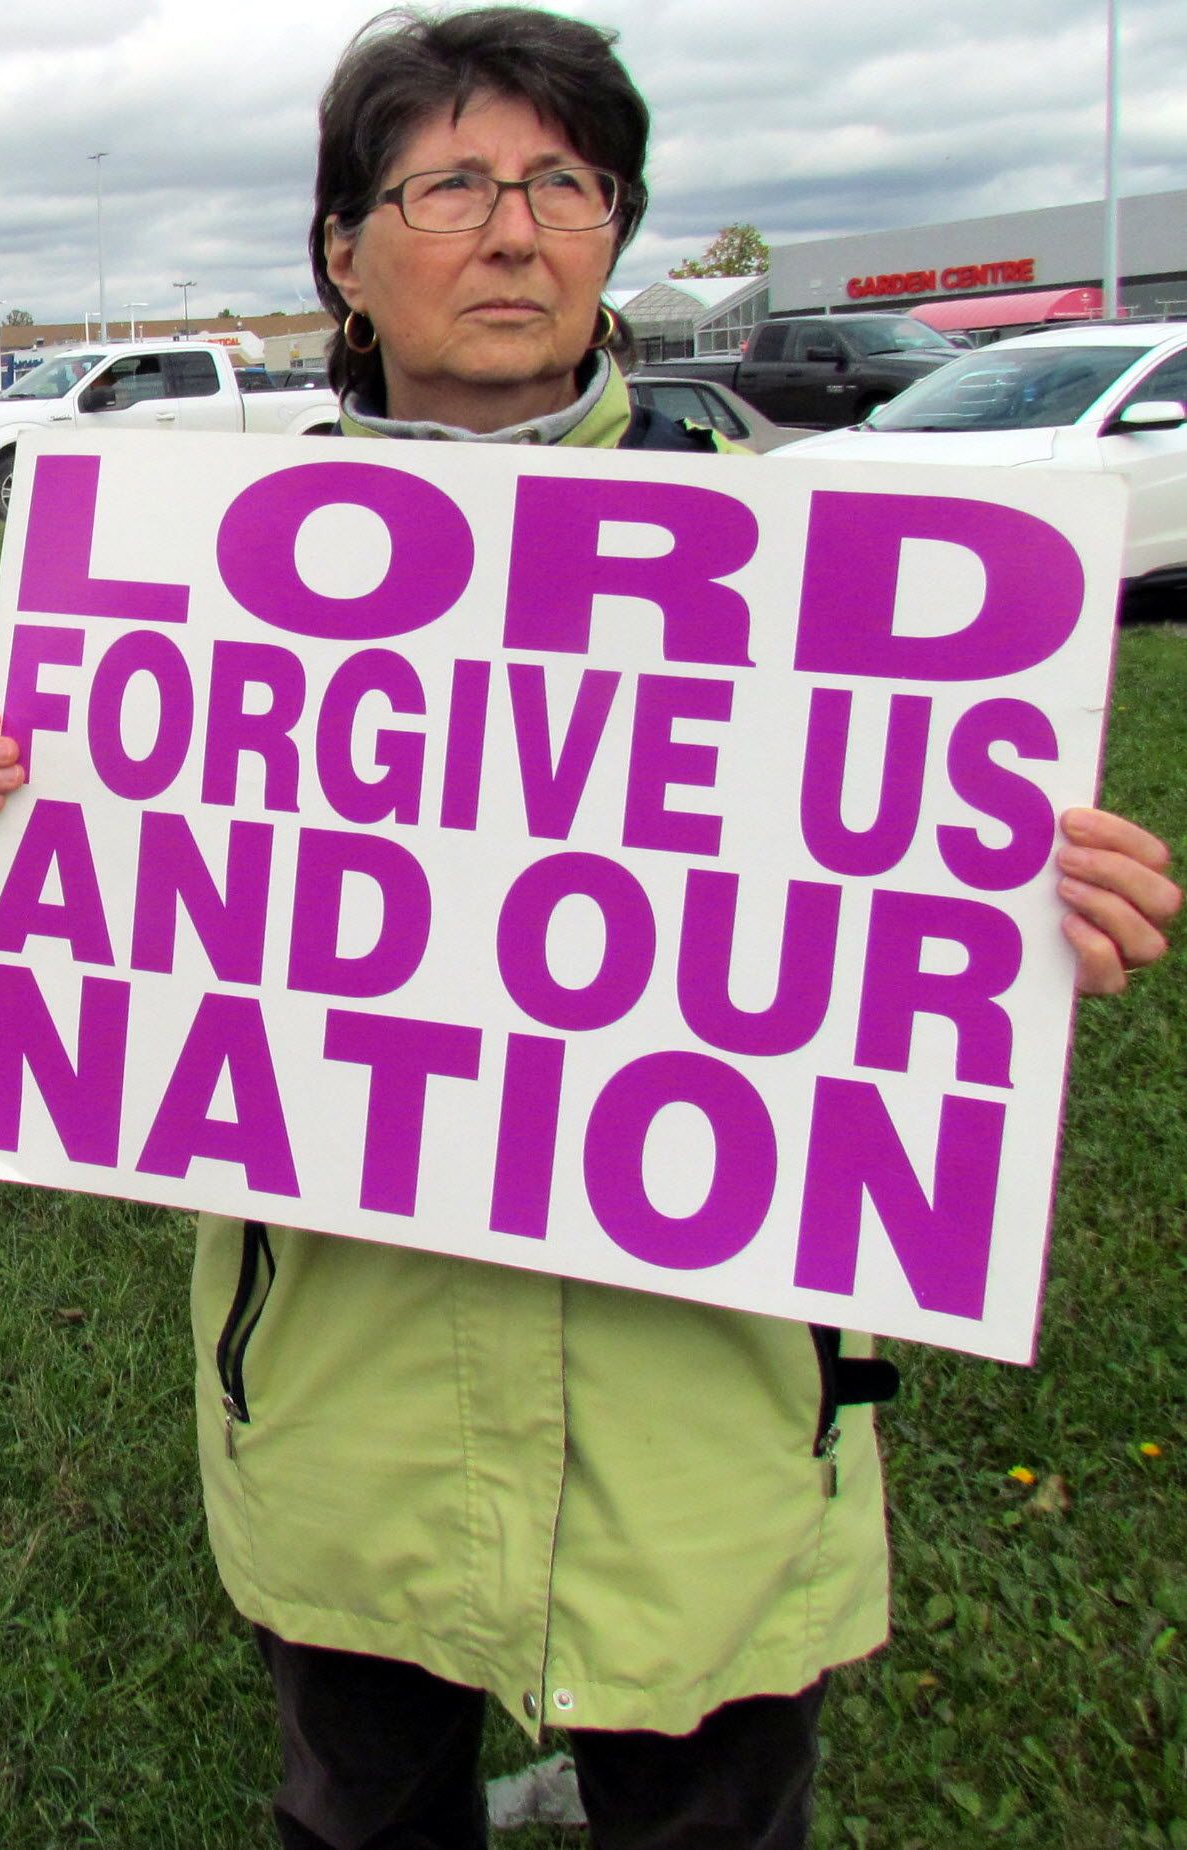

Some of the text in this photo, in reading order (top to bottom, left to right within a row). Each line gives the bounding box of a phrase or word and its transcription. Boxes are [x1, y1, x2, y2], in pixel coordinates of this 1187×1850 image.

[846, 257, 1035, 300] GARDEN CENTRE
[16, 454, 1087, 682] LORD
[0, 624, 1059, 892] FORGIVE US
[496, 850, 1023, 1089] OUR
